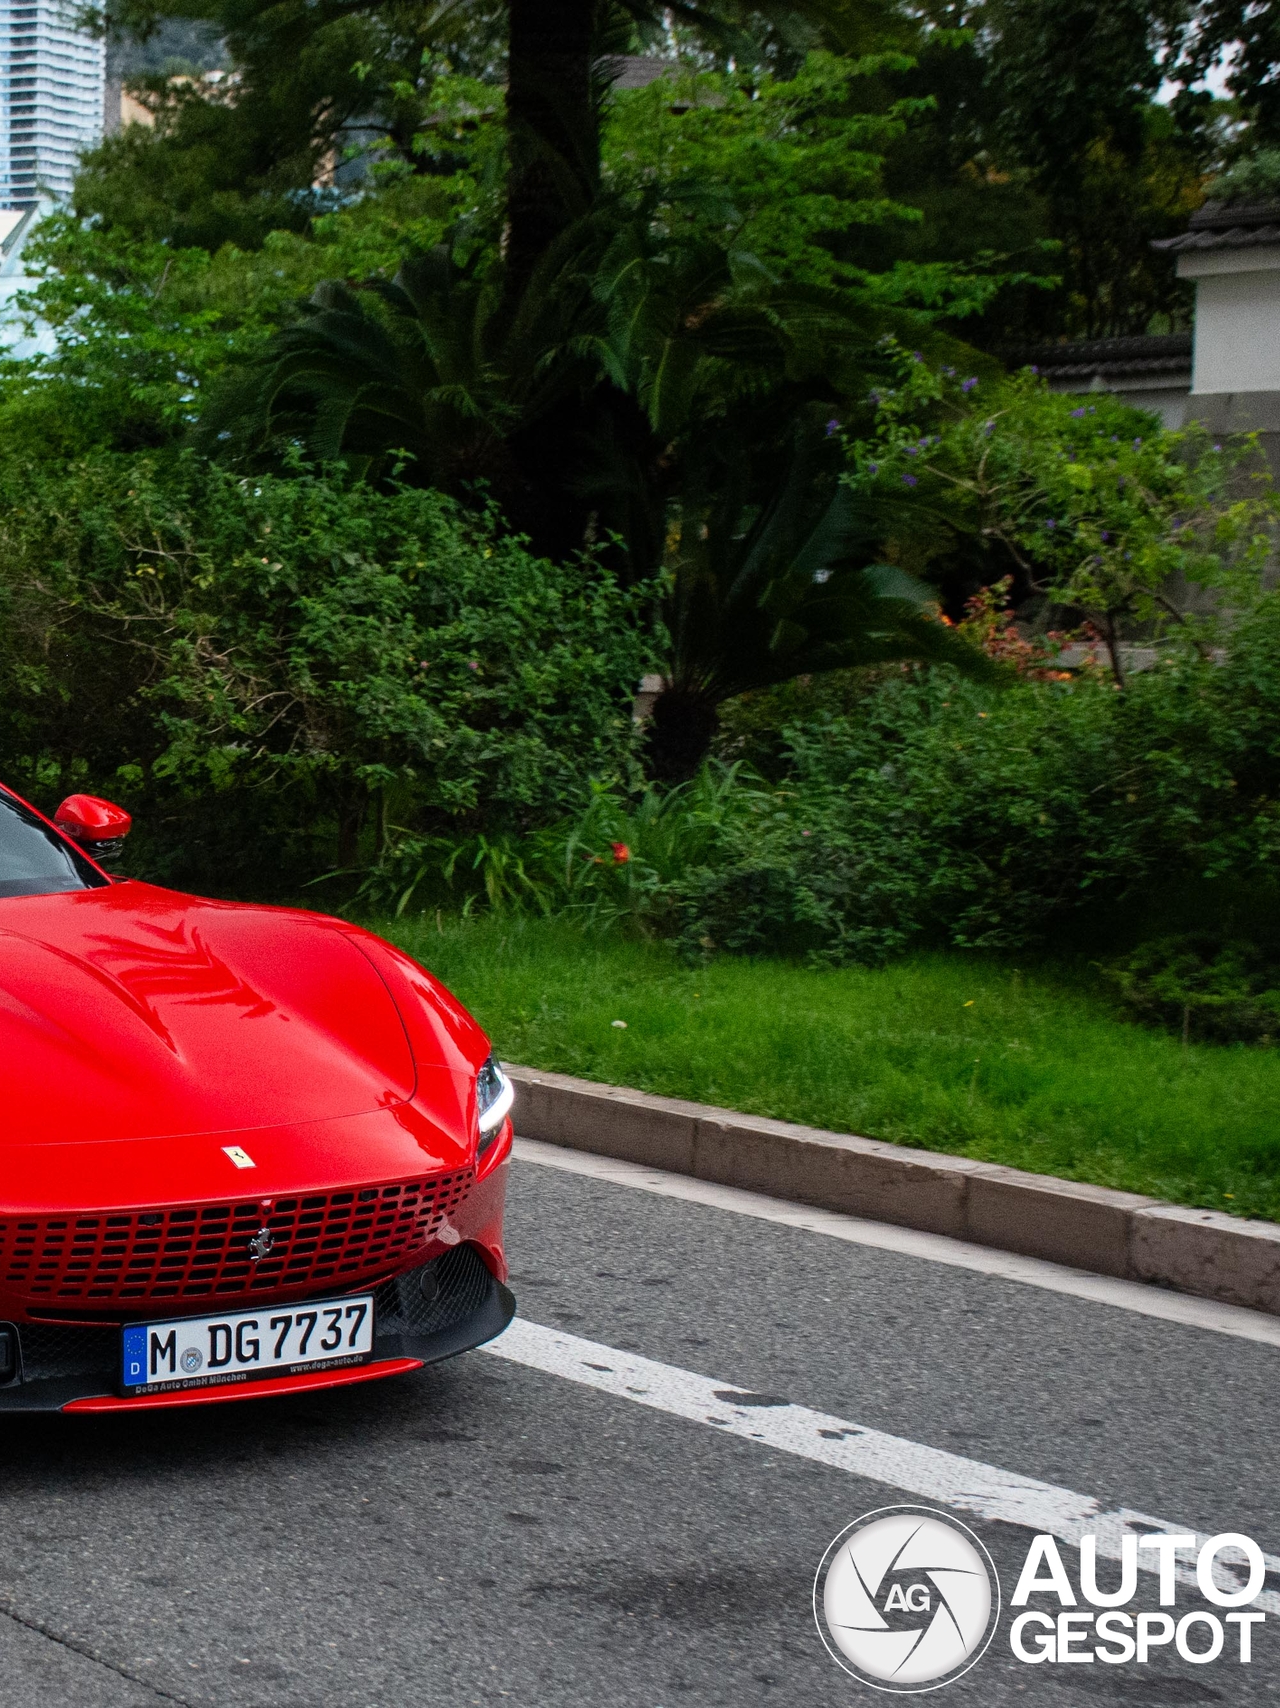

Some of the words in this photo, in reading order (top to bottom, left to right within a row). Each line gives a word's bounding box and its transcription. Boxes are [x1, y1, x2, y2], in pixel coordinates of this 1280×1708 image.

[150, 1329, 177, 1375] M
[207, 1320, 261, 1368] DG
[269, 1303, 368, 1359] 7737
[130, 1362, 141, 1375] D
[160, 1381, 181, 1391] Auto
[182, 1377, 208, 1387] GmbH
[209, 1372, 247, 1384] München
